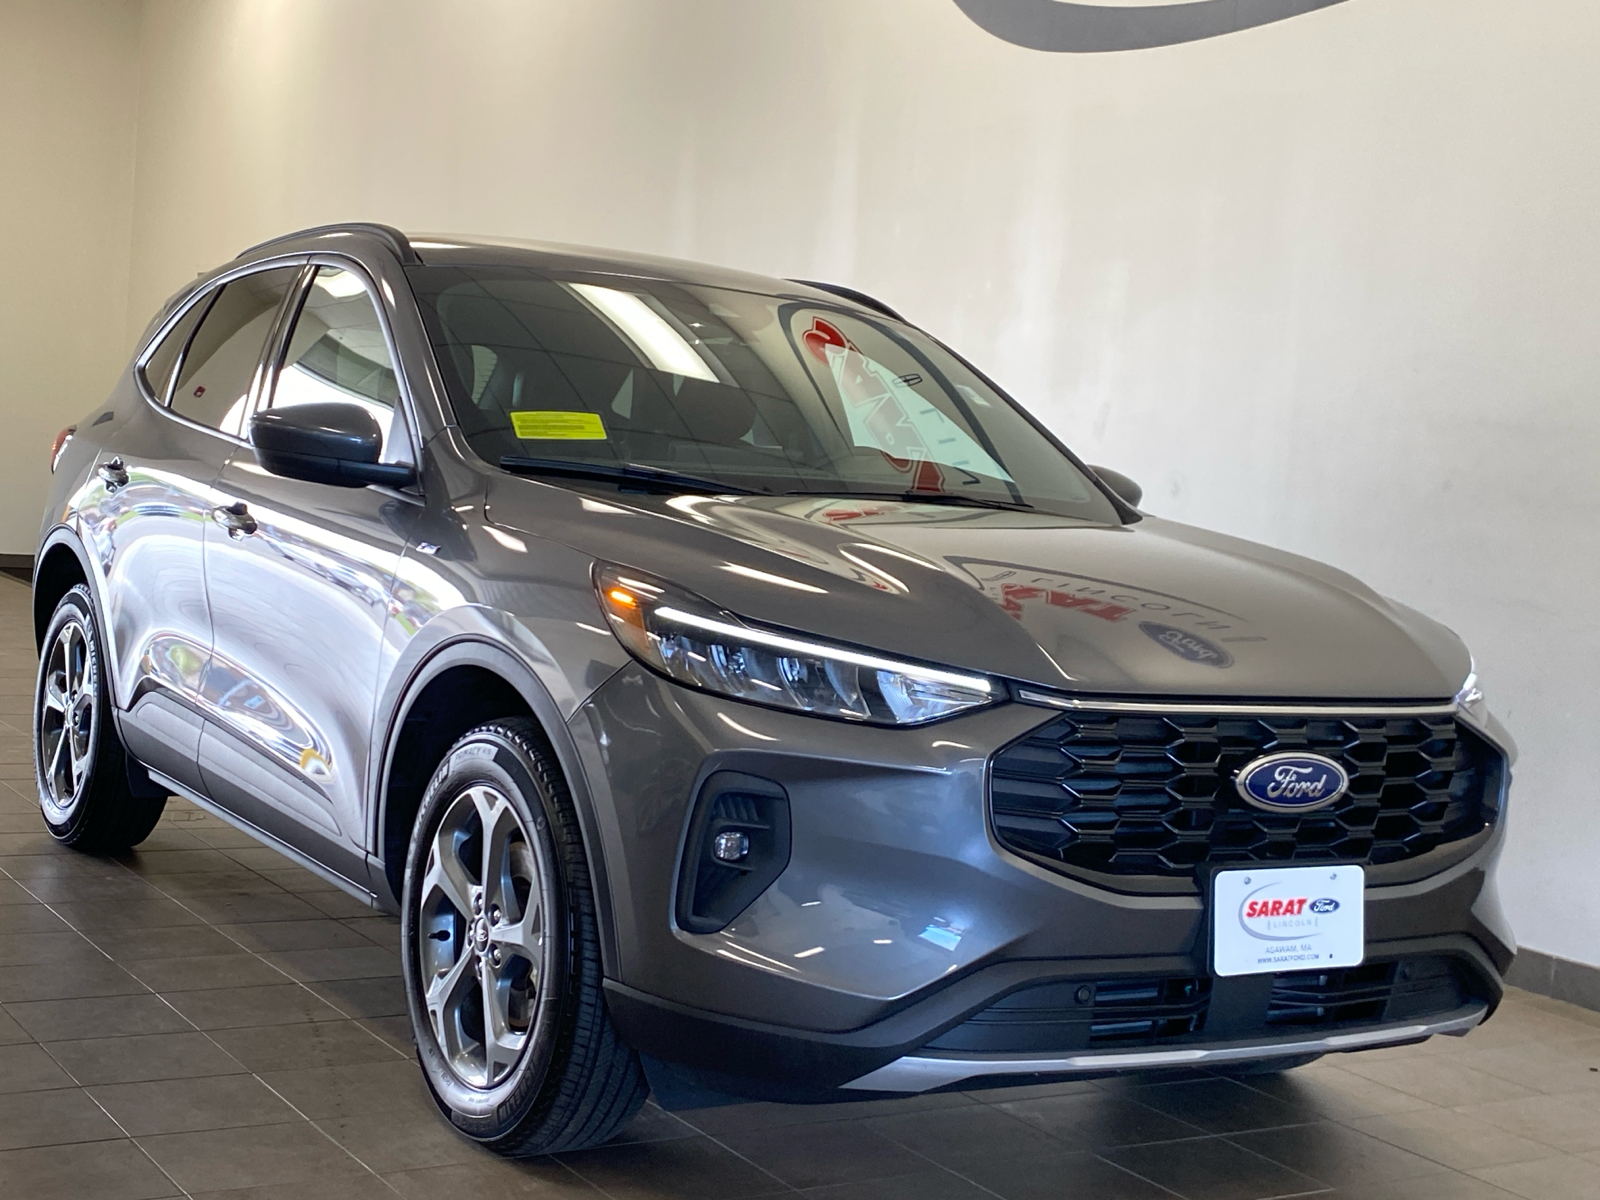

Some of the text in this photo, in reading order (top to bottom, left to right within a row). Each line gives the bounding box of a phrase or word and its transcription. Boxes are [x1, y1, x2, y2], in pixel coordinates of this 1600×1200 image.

[1267, 766, 1327, 798] Ford
[1246, 898, 1307, 918] SARAT
[1301, 944, 1312, 952] MA
